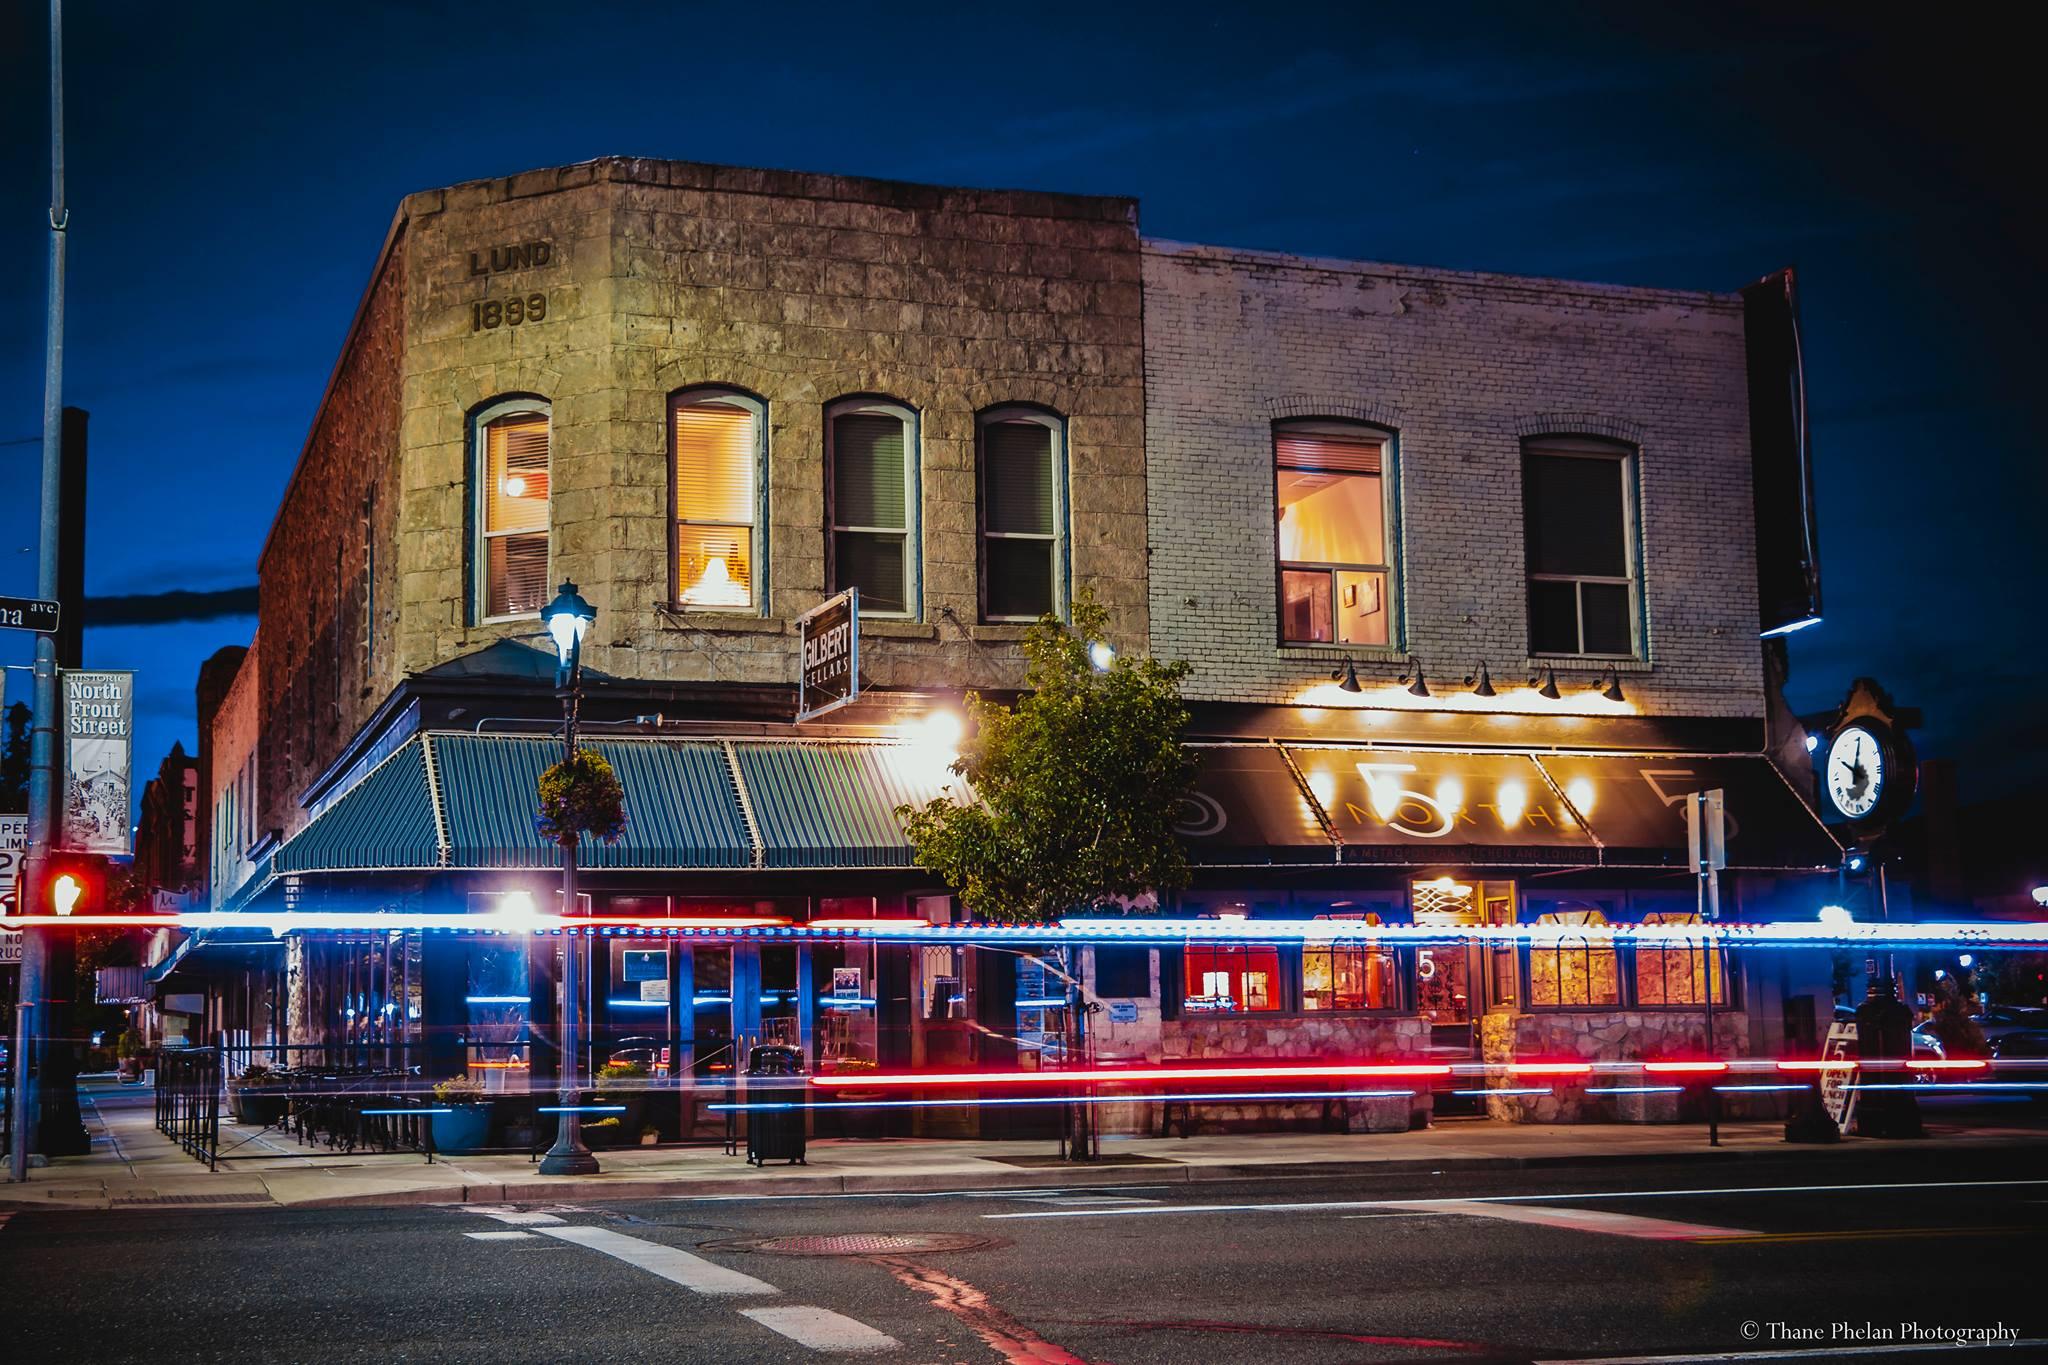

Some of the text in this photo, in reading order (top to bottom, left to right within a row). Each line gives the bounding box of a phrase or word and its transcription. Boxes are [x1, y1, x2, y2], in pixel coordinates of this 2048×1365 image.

[471, 241, 550, 276] LUND
[31, 603, 57, 614] ave.
[804, 622, 849, 671] GILBERT
[804, 656, 848, 688] CELLARS
[70, 682, 122, 699] North
[70, 700, 121, 718] Front
[71, 717, 126, 735] Street
[5, 934, 22, 945] NO
[1419, 950, 1435, 978] 5
